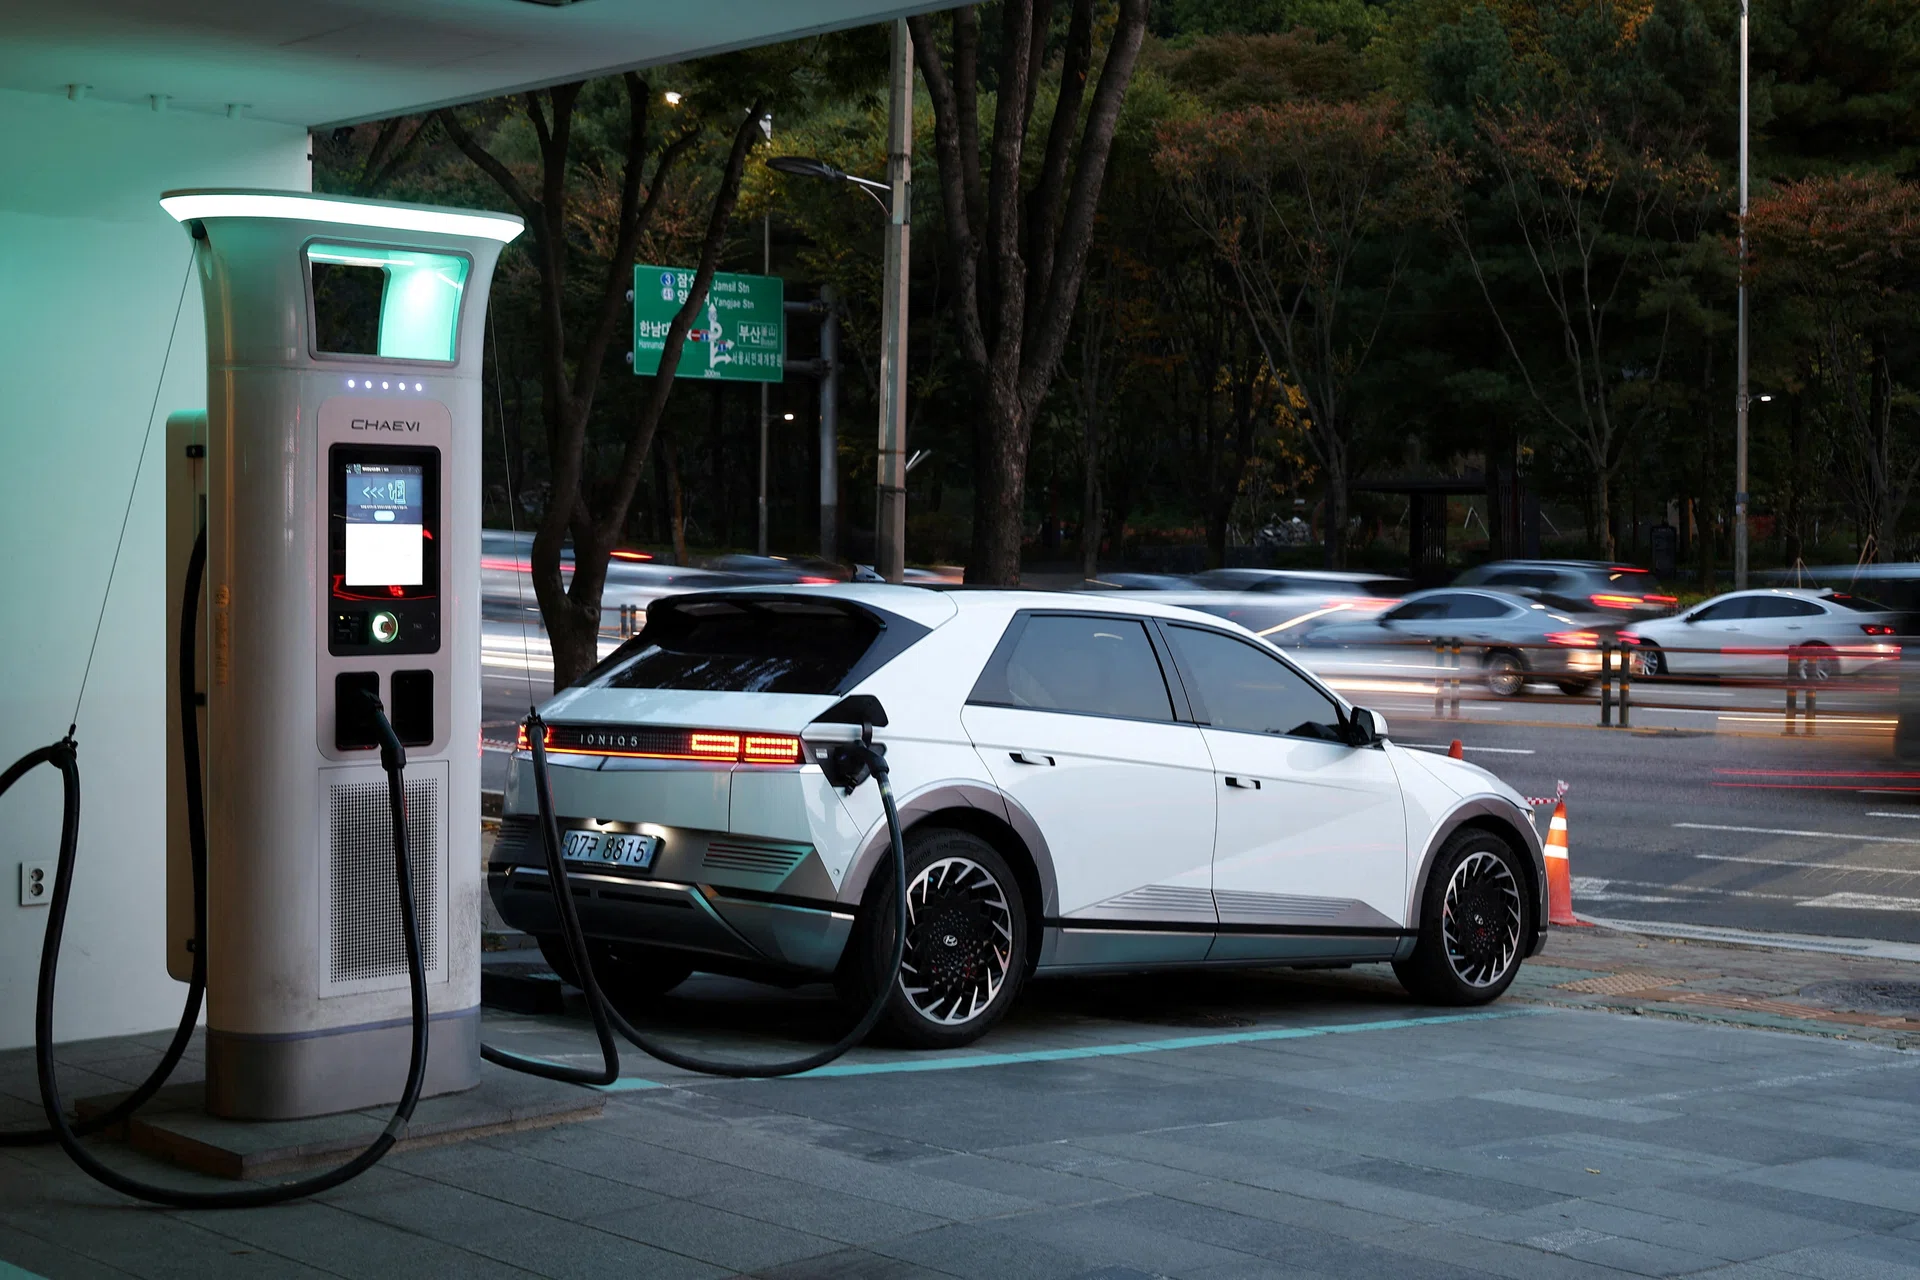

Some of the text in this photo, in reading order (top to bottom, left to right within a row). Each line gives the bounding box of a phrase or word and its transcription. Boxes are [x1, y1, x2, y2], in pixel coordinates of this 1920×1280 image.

[713, 280, 750, 294] Jamsil Stn
[713, 297, 755, 310] Yangjae Stn
[739, 324, 761, 343] 부산
[351, 418, 420, 432] CHAEVI
[567, 833, 648, 863] 07구 8815
